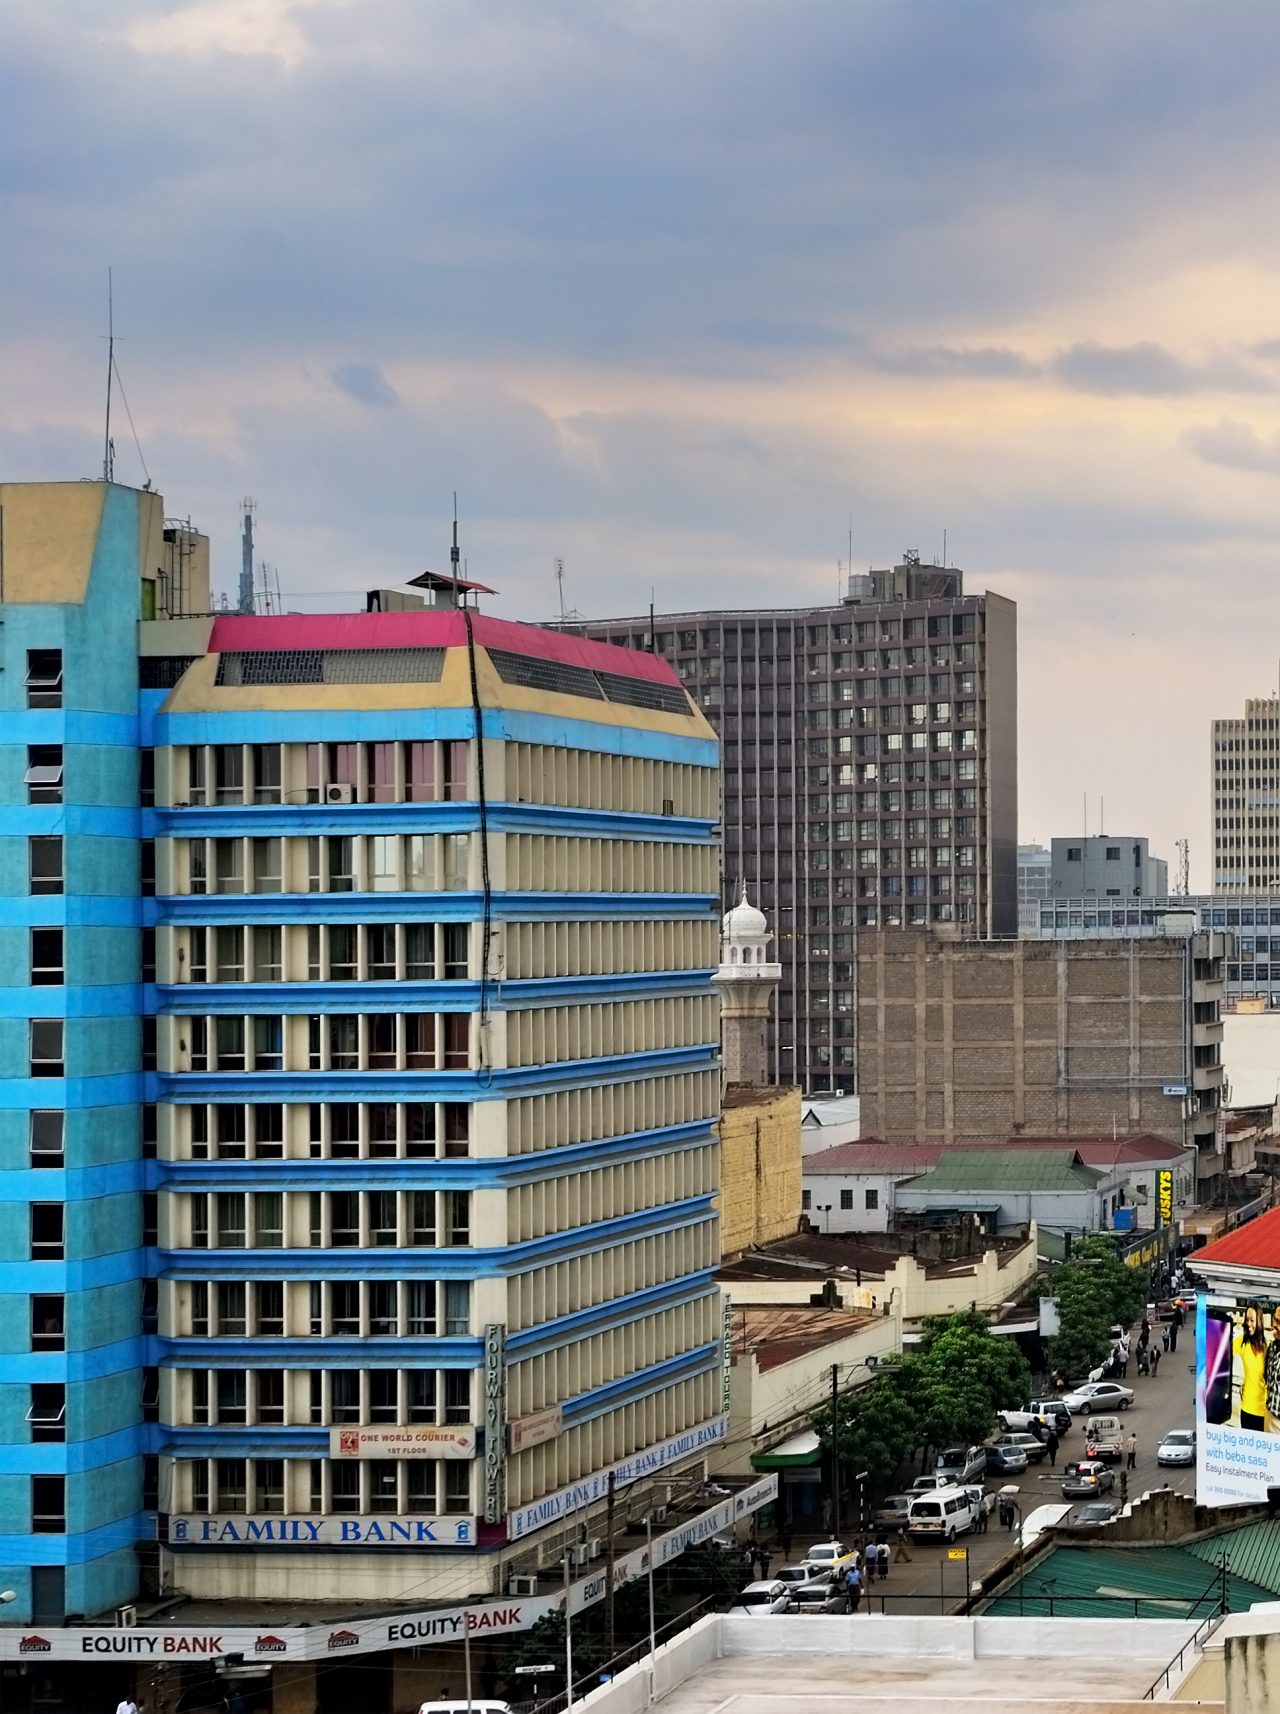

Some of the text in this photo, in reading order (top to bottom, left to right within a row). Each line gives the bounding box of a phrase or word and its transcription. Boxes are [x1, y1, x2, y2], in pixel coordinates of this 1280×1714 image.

[486, 1325, 500, 1524] FOURWAY TOWERS
[361, 1433, 456, 1443] ONE WORLD COURIER
[668, 1433, 697, 1459] FAMILY
[698, 1423, 718, 1446] BANK
[1206, 1429, 1222, 1444] buy
[1223, 1432, 1237, 1447] big
[1239, 1436, 1254, 1447] and
[1256, 1441, 1272, 1453] pay
[1206, 1447, 1268, 1467] with beba sasa
[602, 1451, 658, 1492] FMILY BANK
[1206, 1462, 1274, 1483] Easy Instalment Plan
[527, 1484, 590, 1527] FAMILY BANK
[201, 1520, 438, 1542] FAMILY BANK
[698, 1513, 718, 1539] BANK
[584, 1563, 628, 1602] EQUIT ANK
[388, 1607, 522, 1641] EQUITY BANK
[20, 1643, 50, 1651] EQUITY
[82, 1636, 223, 1653] EQUITY BANK
[255, 1643, 286, 1651] EQUITY
